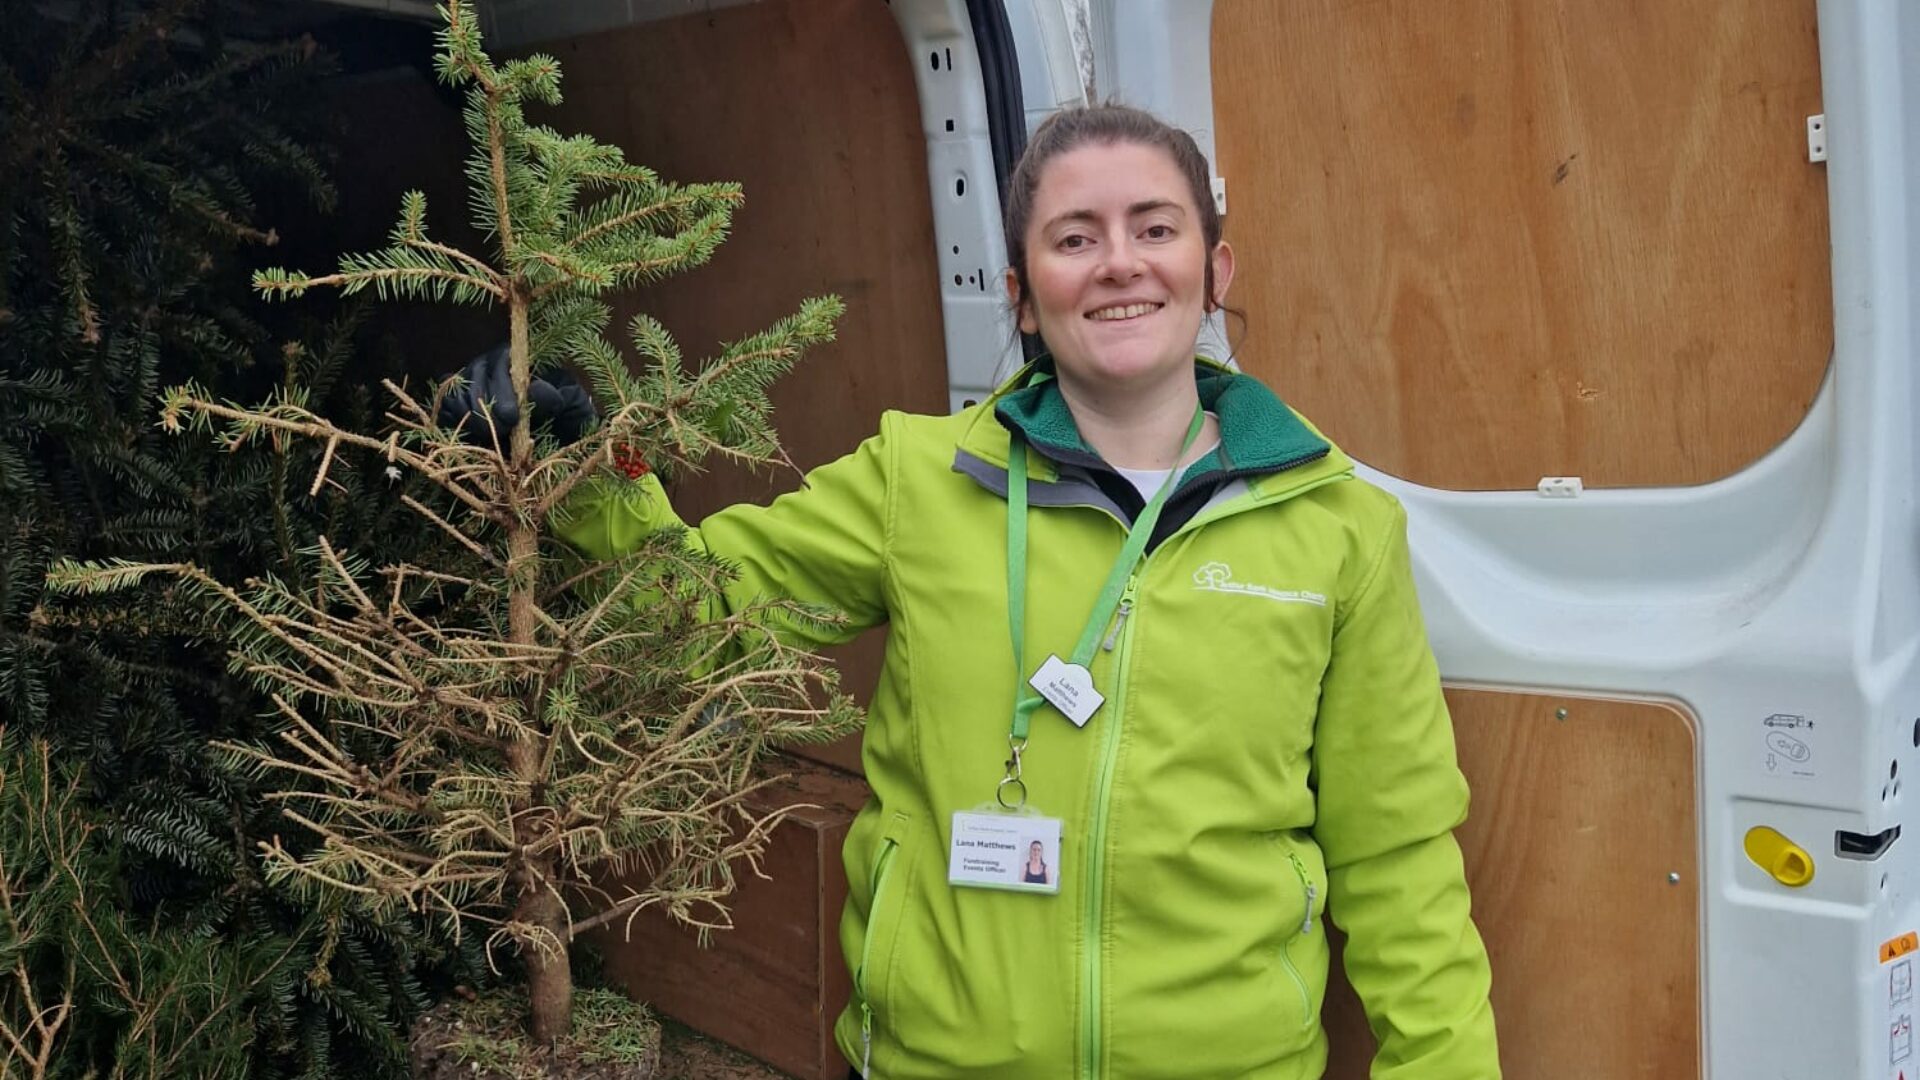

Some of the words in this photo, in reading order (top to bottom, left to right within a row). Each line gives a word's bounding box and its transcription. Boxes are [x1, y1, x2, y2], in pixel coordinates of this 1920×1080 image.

[1059, 677, 1079, 697] Lana
[956, 839, 975, 847] Lana
[977, 840, 1016, 850] Matthews
